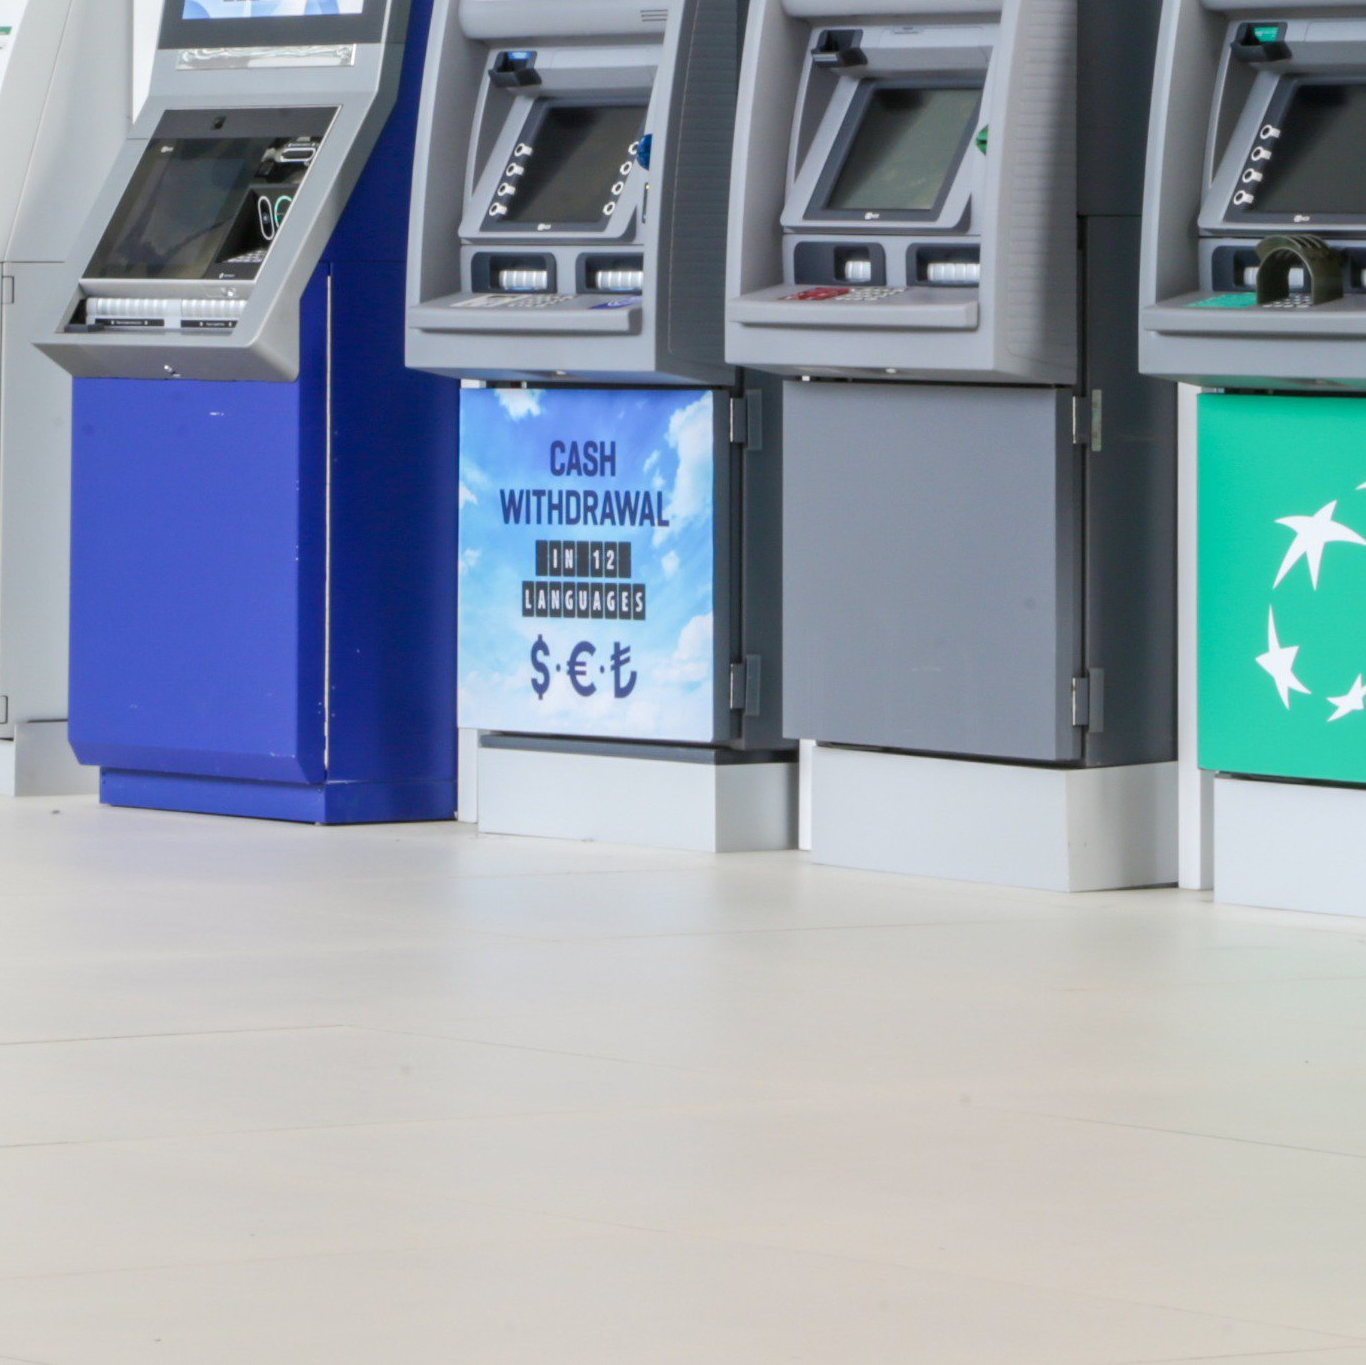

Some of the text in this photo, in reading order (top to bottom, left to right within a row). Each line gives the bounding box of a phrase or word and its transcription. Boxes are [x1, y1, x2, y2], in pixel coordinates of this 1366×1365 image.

[549, 440, 616, 477] CASH
[499, 489, 670, 527] WITHDRAWAL
[552, 548, 615, 570] IN 12
[524, 589, 644, 613] LANGUAGES
